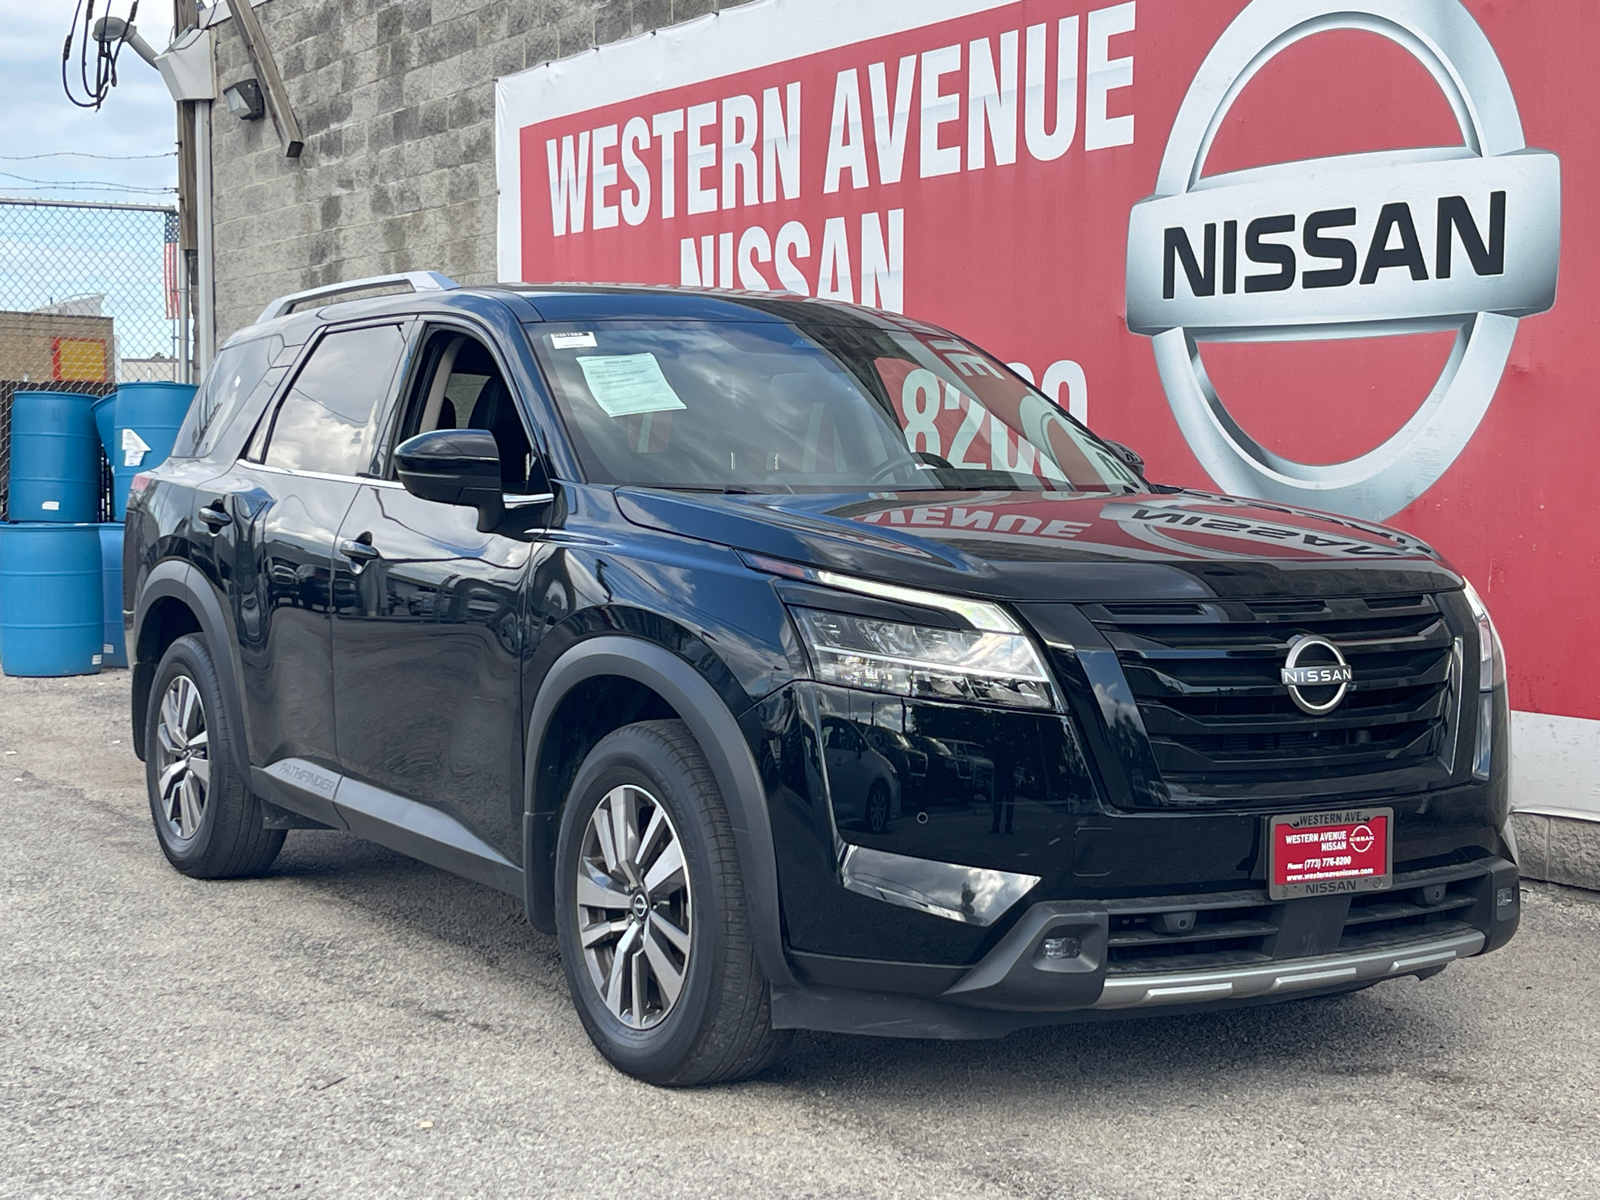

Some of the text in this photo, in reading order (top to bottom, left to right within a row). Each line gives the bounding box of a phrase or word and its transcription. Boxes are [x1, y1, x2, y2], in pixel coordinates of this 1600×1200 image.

[546, 1, 1137, 237] WESTERN AVENUE
[1163, 190, 1506, 299] NISSAN
[1284, 668, 1352, 683] NISSAN
[280, 762, 337, 792] PATHFINDER
[1300, 812, 1361, 826] WESTERN AVE
[1285, 831, 1346, 844] WESTERN AVENUE
[1321, 841, 1346, 852] NISSAN
[1304, 858, 1321, 870] (773)
[1322, 856, 1352, 867] 776-8200
[1305, 881, 1356, 893] NISSAN
